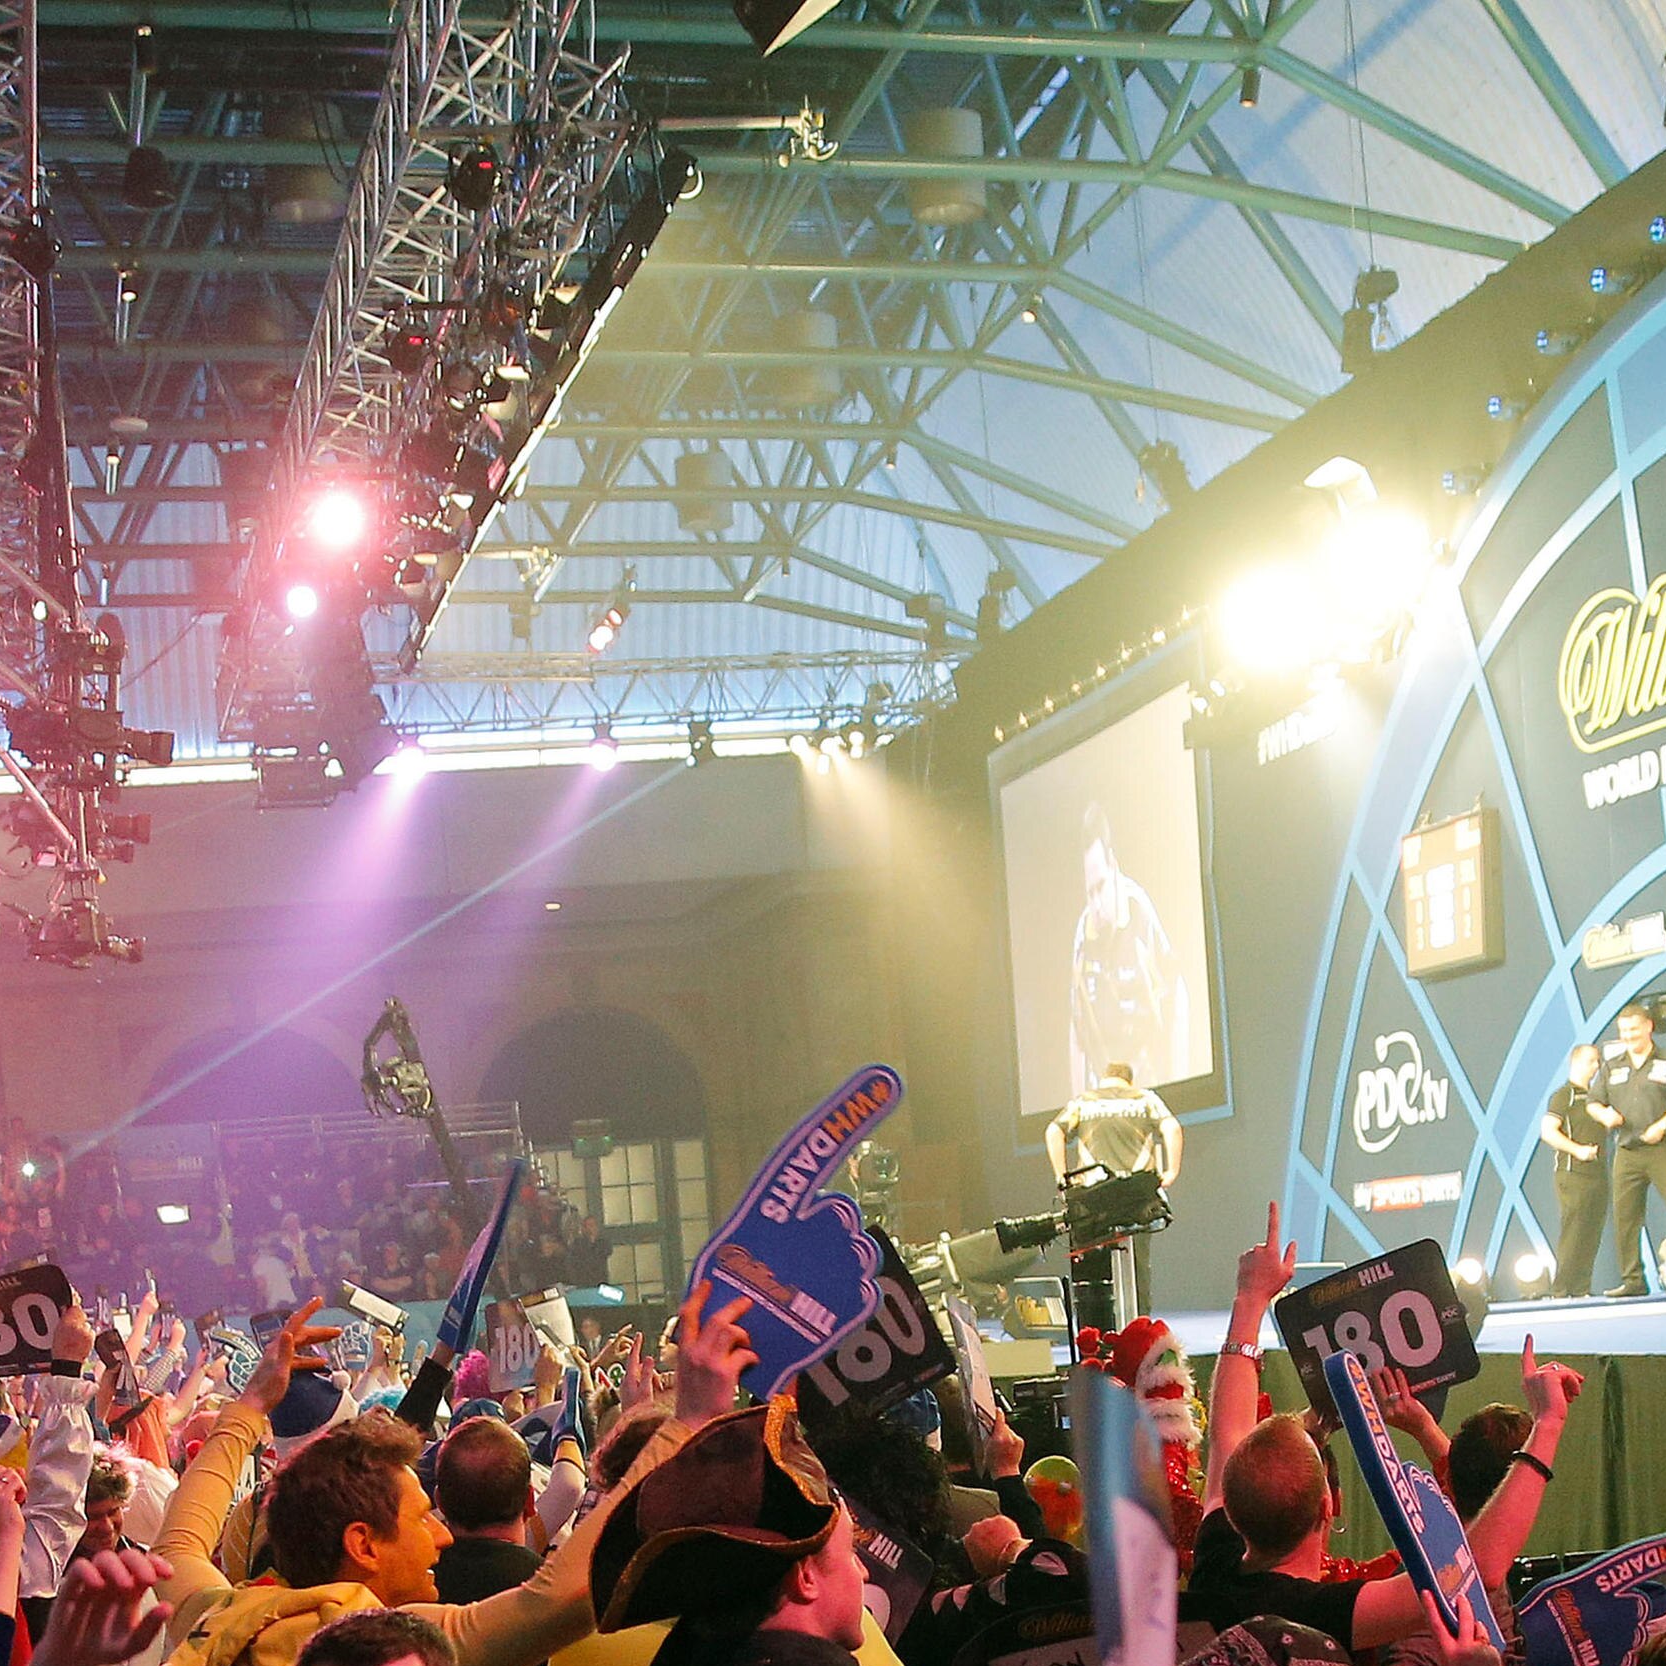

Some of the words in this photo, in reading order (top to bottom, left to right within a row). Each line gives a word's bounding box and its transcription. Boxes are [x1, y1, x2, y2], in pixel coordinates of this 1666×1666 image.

[1583, 749, 1661, 809] WORLD
[1355, 1060, 1449, 1134] PDC.tv
[760, 1080, 893, 1224] #WHDARTS
[1357, 1262, 1395, 1287] HILL
[1301, 1289, 1443, 1378] 180
[1347, 1360, 1426, 1534] #WHDARTS
[868, 1533, 904, 1570] HILL
